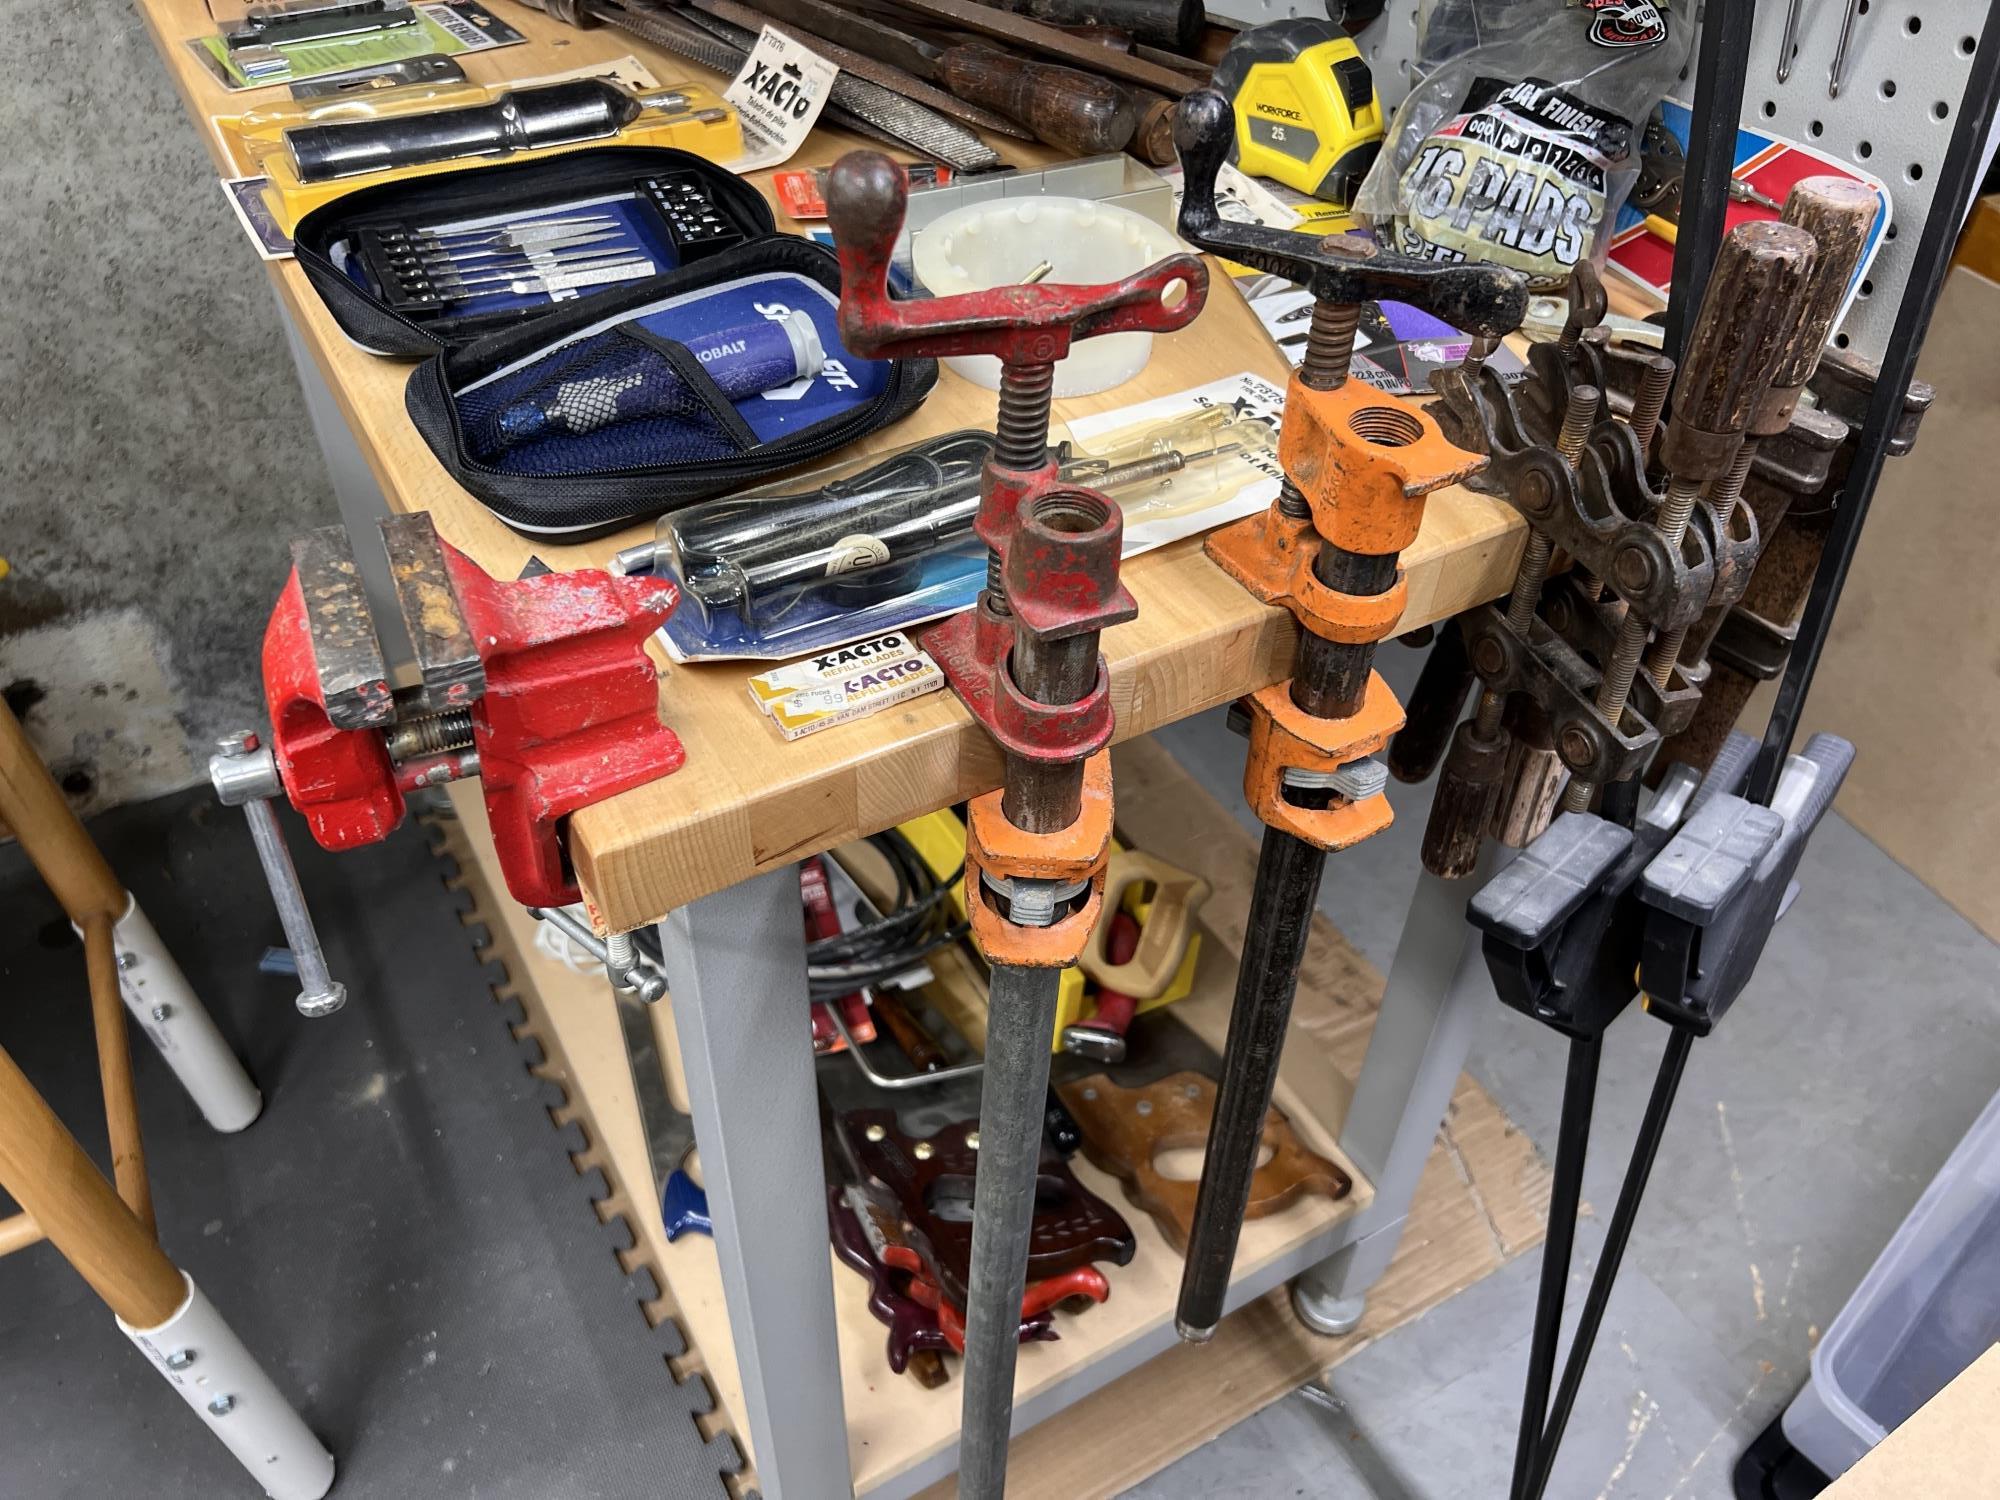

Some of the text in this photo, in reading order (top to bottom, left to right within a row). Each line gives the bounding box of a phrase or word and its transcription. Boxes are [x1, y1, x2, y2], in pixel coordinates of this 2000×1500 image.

[742, 60, 811, 120] X-ACTO
[1256, 102, 1301, 120] WORKFORCE
[1271, 126, 1285, 141] 25
[1469, 119, 1493, 138] 000
[1553, 150, 1563, 166] 1
[1408, 145, 1594, 266] 16 PADS
[812, 636, 900, 672] X-ACTO
[823, 649, 905, 679] REFILL BLADES
[888, 666, 935, 689] BLADES
